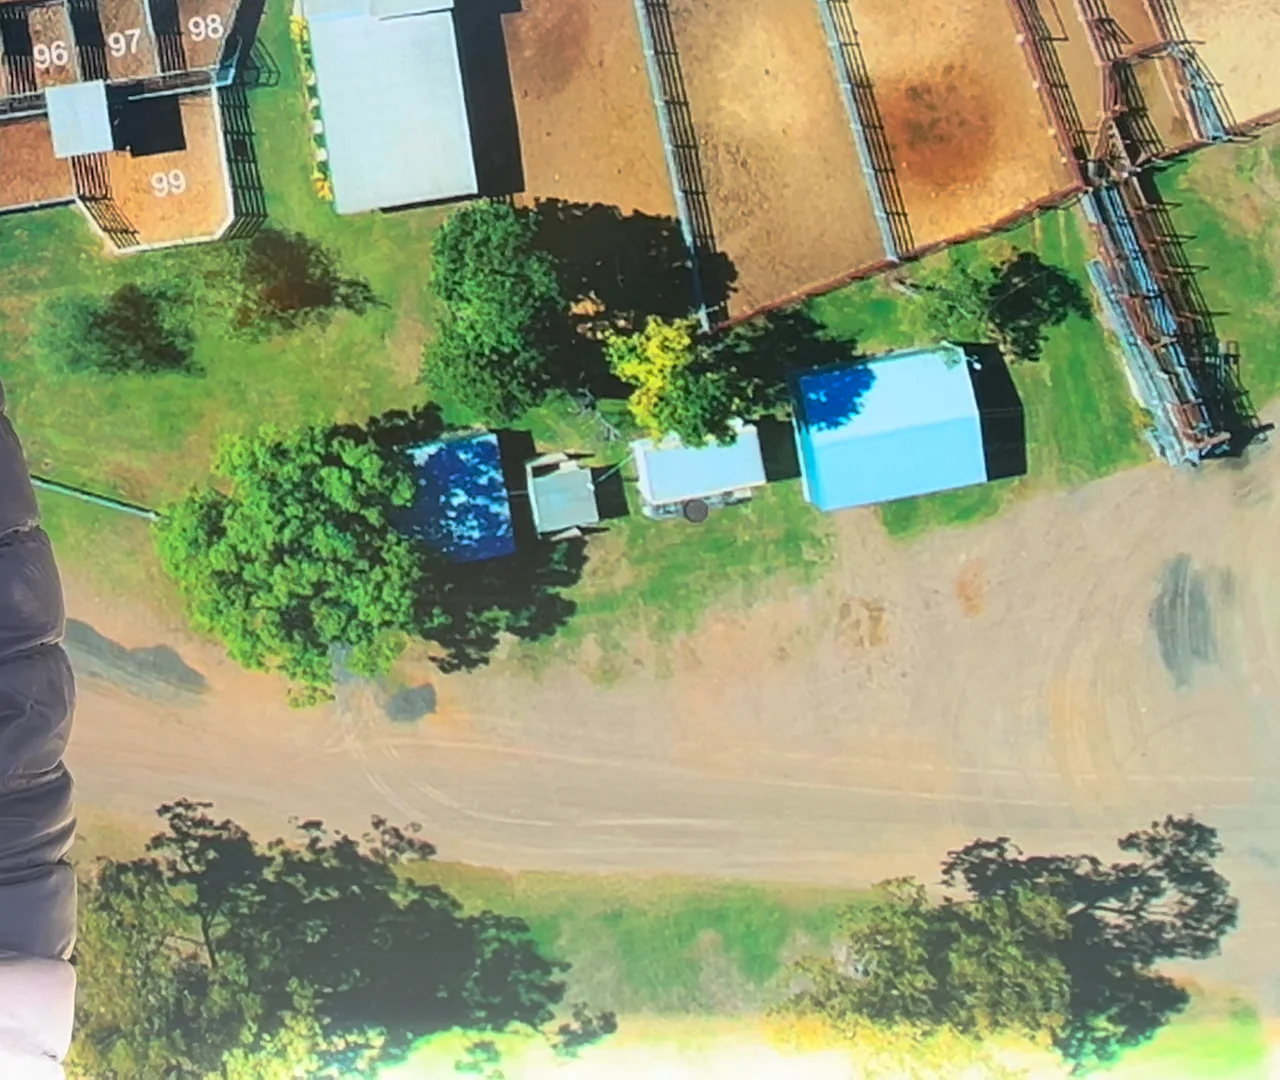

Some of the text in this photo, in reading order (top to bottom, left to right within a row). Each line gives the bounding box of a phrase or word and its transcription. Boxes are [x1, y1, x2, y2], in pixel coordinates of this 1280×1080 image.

[188, 14, 224, 41] 98
[33, 41, 69, 69] 96
[107, 28, 141, 58] 97
[150, 169, 186, 198] 99
